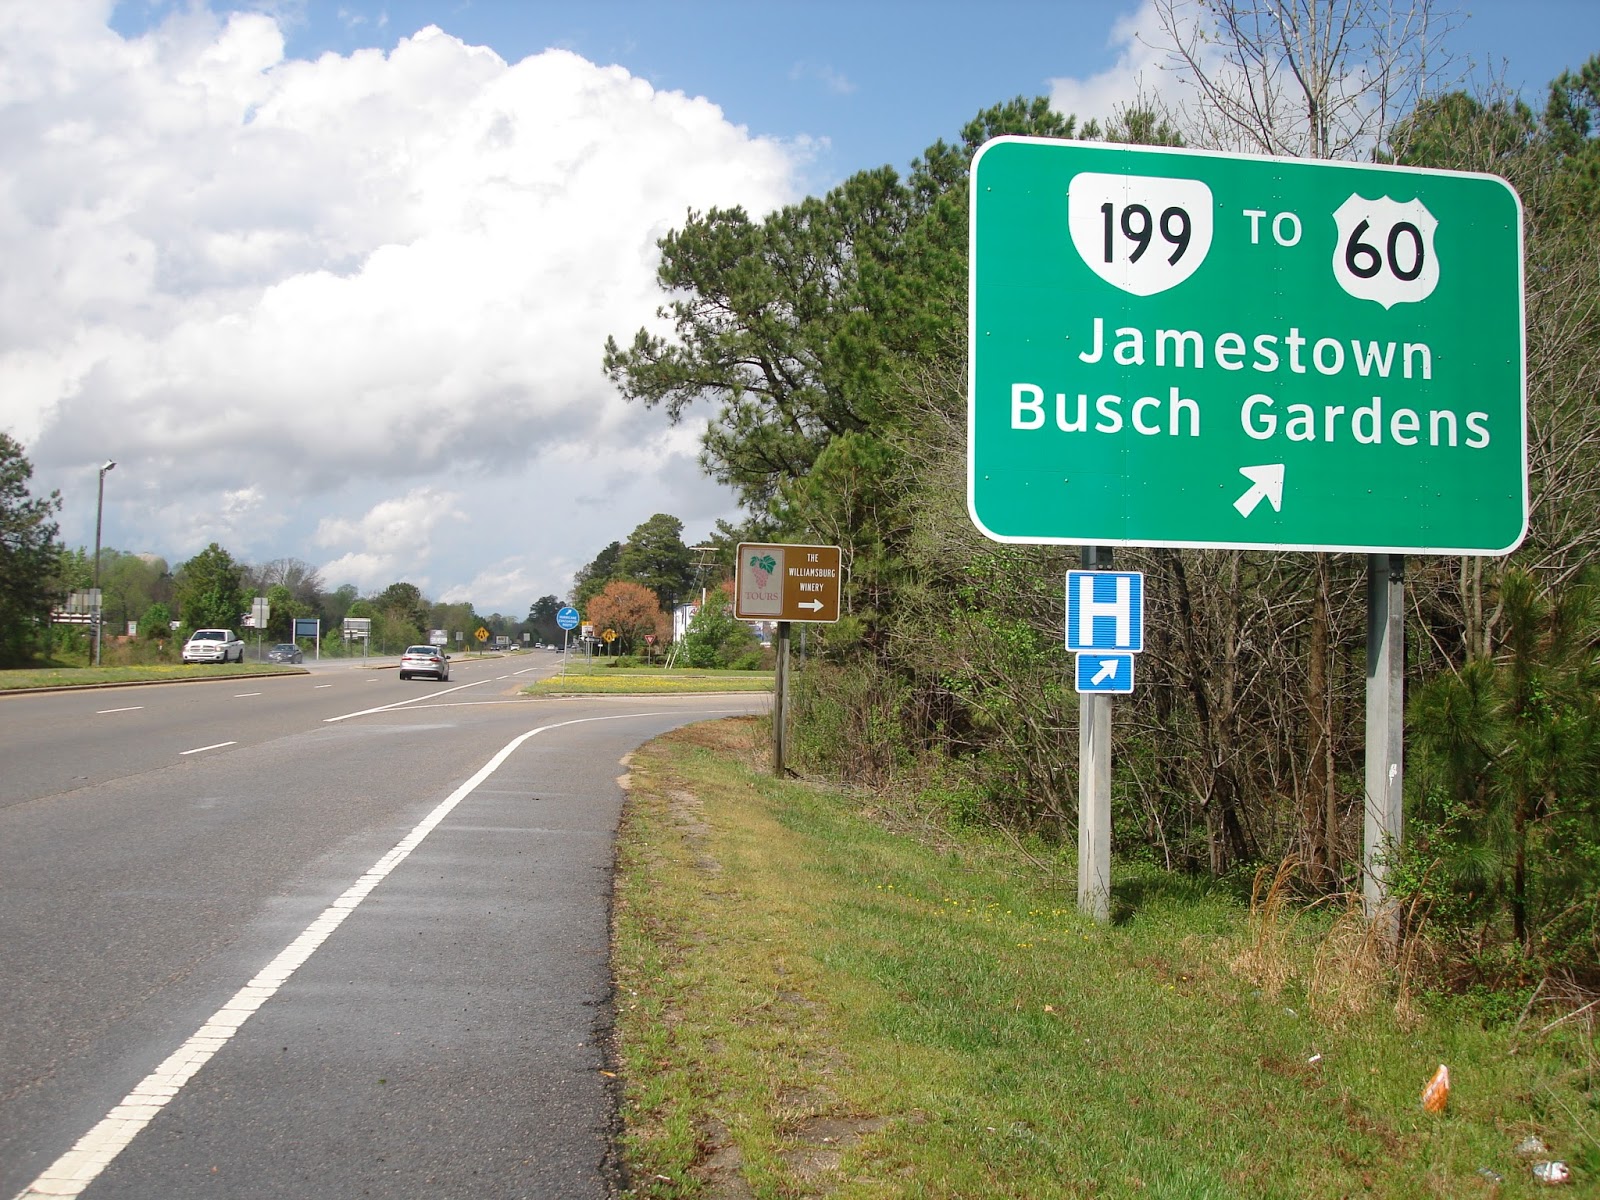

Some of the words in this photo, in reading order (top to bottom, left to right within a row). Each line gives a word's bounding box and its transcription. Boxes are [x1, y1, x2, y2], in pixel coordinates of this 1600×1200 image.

[1100, 202, 1192, 267] 199
[1242, 209, 1302, 247] TO
[1345, 219, 1425, 282] 60
[1078, 317, 1432, 380] Jamestown
[1011, 383, 1200, 437] Busch
[1240, 393, 1490, 449] Gardens
[789, 567, 835, 578] WILLIAMSBURG
[807, 553, 818, 563] THE
[745, 591, 778, 600] TOURS
[800, 582, 824, 592] WINERY
[1079, 576, 1130, 646] H
